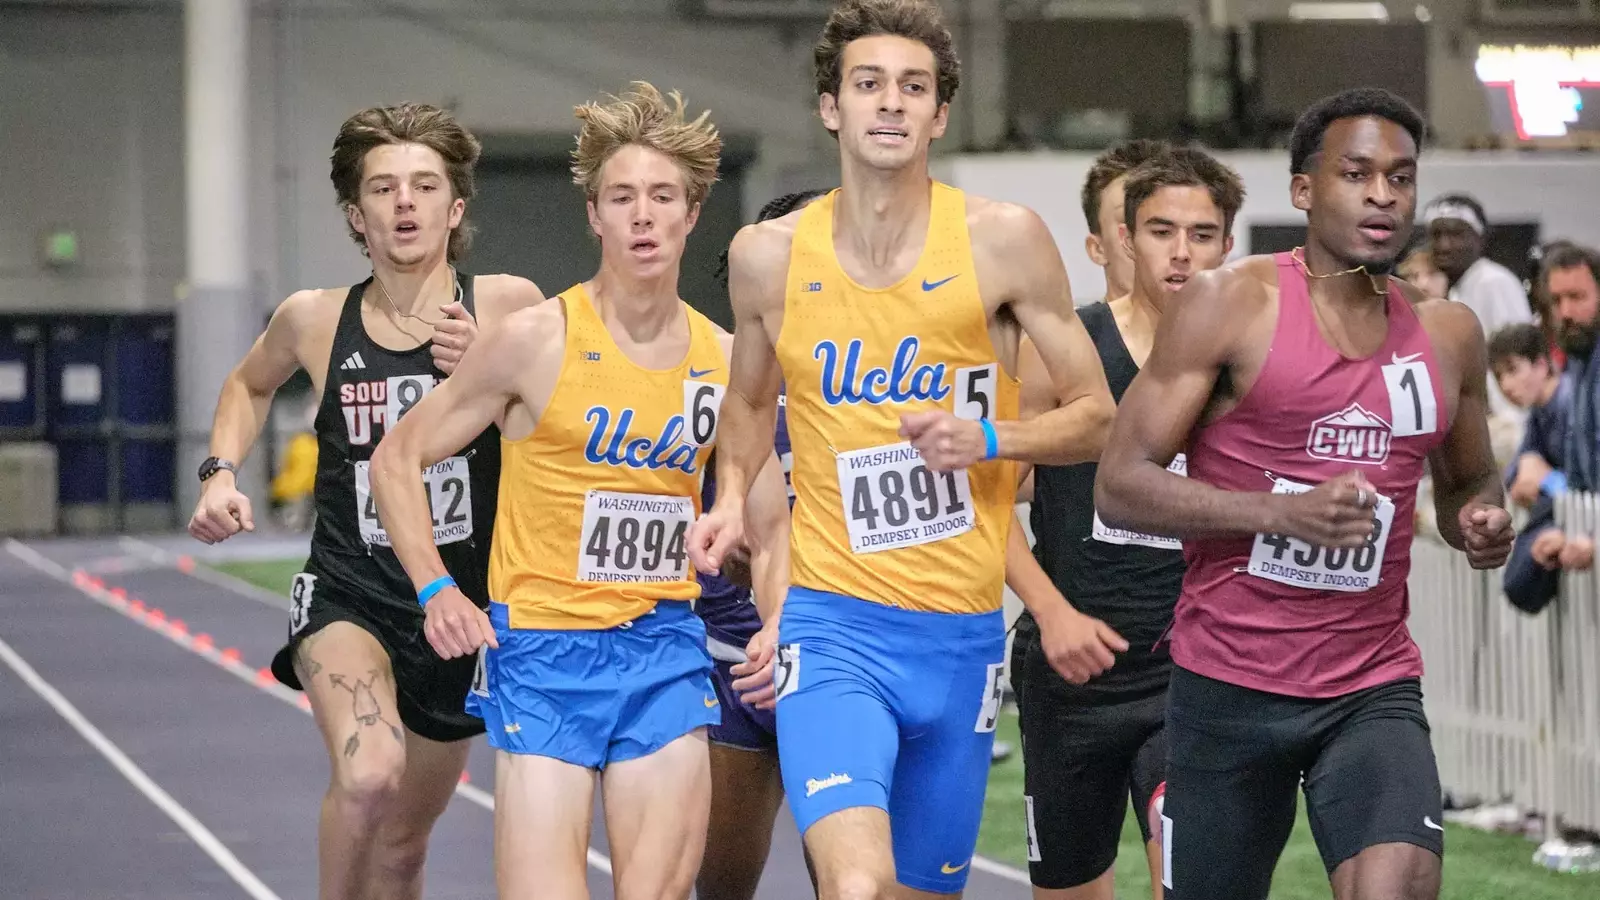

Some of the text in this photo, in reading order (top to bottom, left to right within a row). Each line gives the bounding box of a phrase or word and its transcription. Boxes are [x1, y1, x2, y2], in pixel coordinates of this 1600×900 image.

[966, 368, 989, 419] 5
[1399, 369, 1423, 431] 1
[692, 385, 716, 445] 6
[850, 449, 920, 469] WASHING
[1312, 426, 1388, 459] CWU
[599, 497, 684, 514] WASHINGTON
[851, 465, 965, 531] 4891
[433, 524, 465, 540] NDOOR
[585, 516, 689, 571] 4894
[861, 516, 969, 547] DEMPSEY INDOOR
[588, 571, 641, 582] DEMPSEY
[1260, 562, 1370, 588] DEMPSEY INDOOR
[293, 576, 305, 628] 8
[986, 667, 1004, 729] 5
